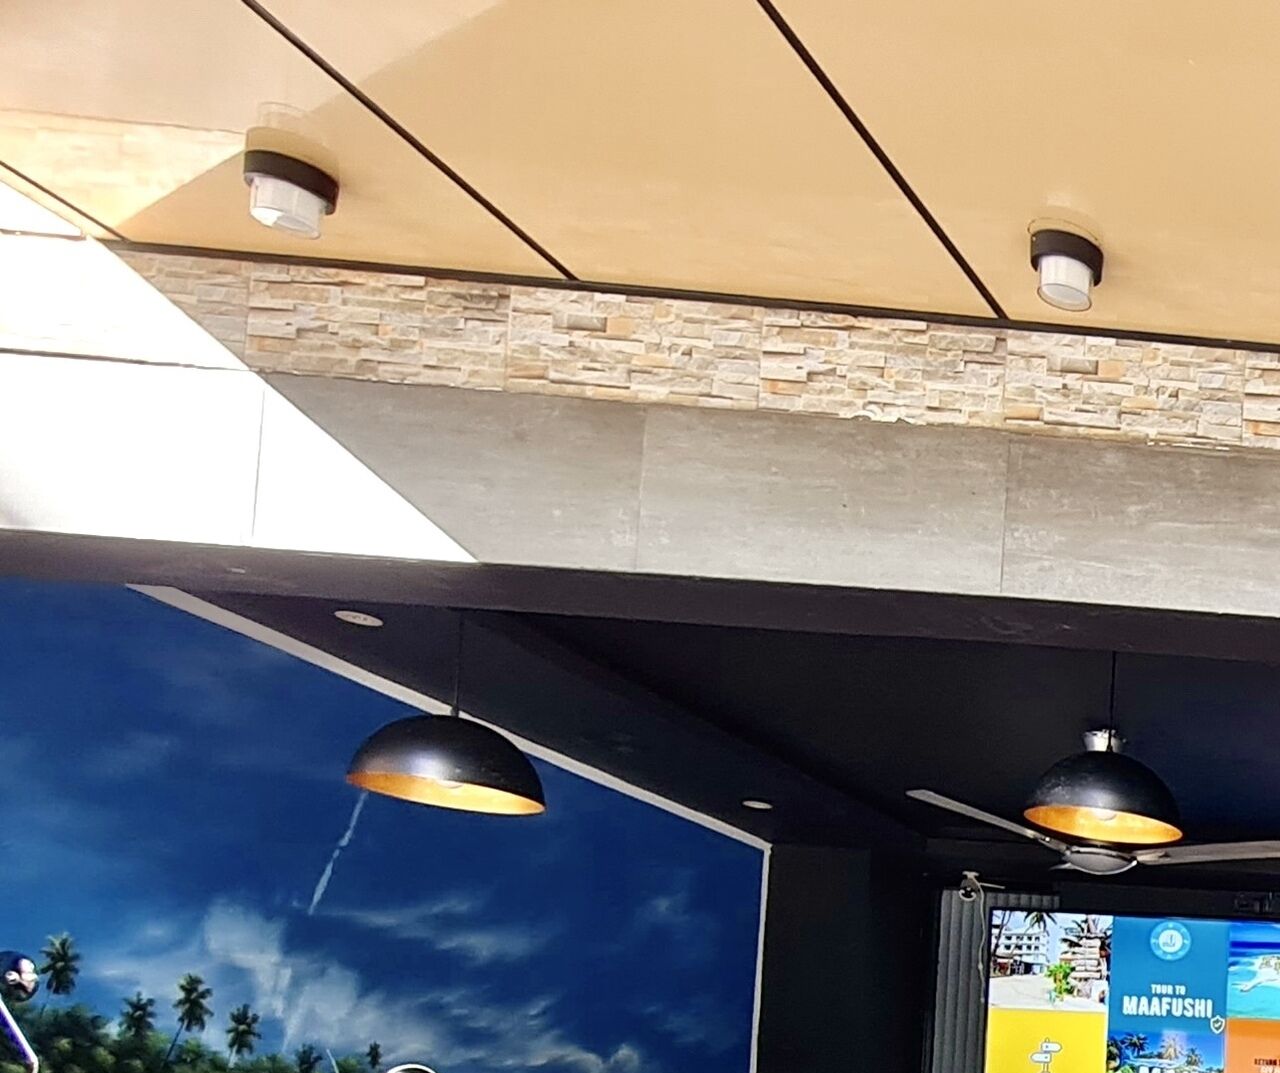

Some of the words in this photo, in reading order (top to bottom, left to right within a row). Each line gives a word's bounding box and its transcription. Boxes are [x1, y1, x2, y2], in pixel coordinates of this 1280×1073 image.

[1151, 984, 1173, 995] TOUR
[1175, 985, 1186, 995] TO
[1122, 996, 1214, 1019] MAAFUSHI
